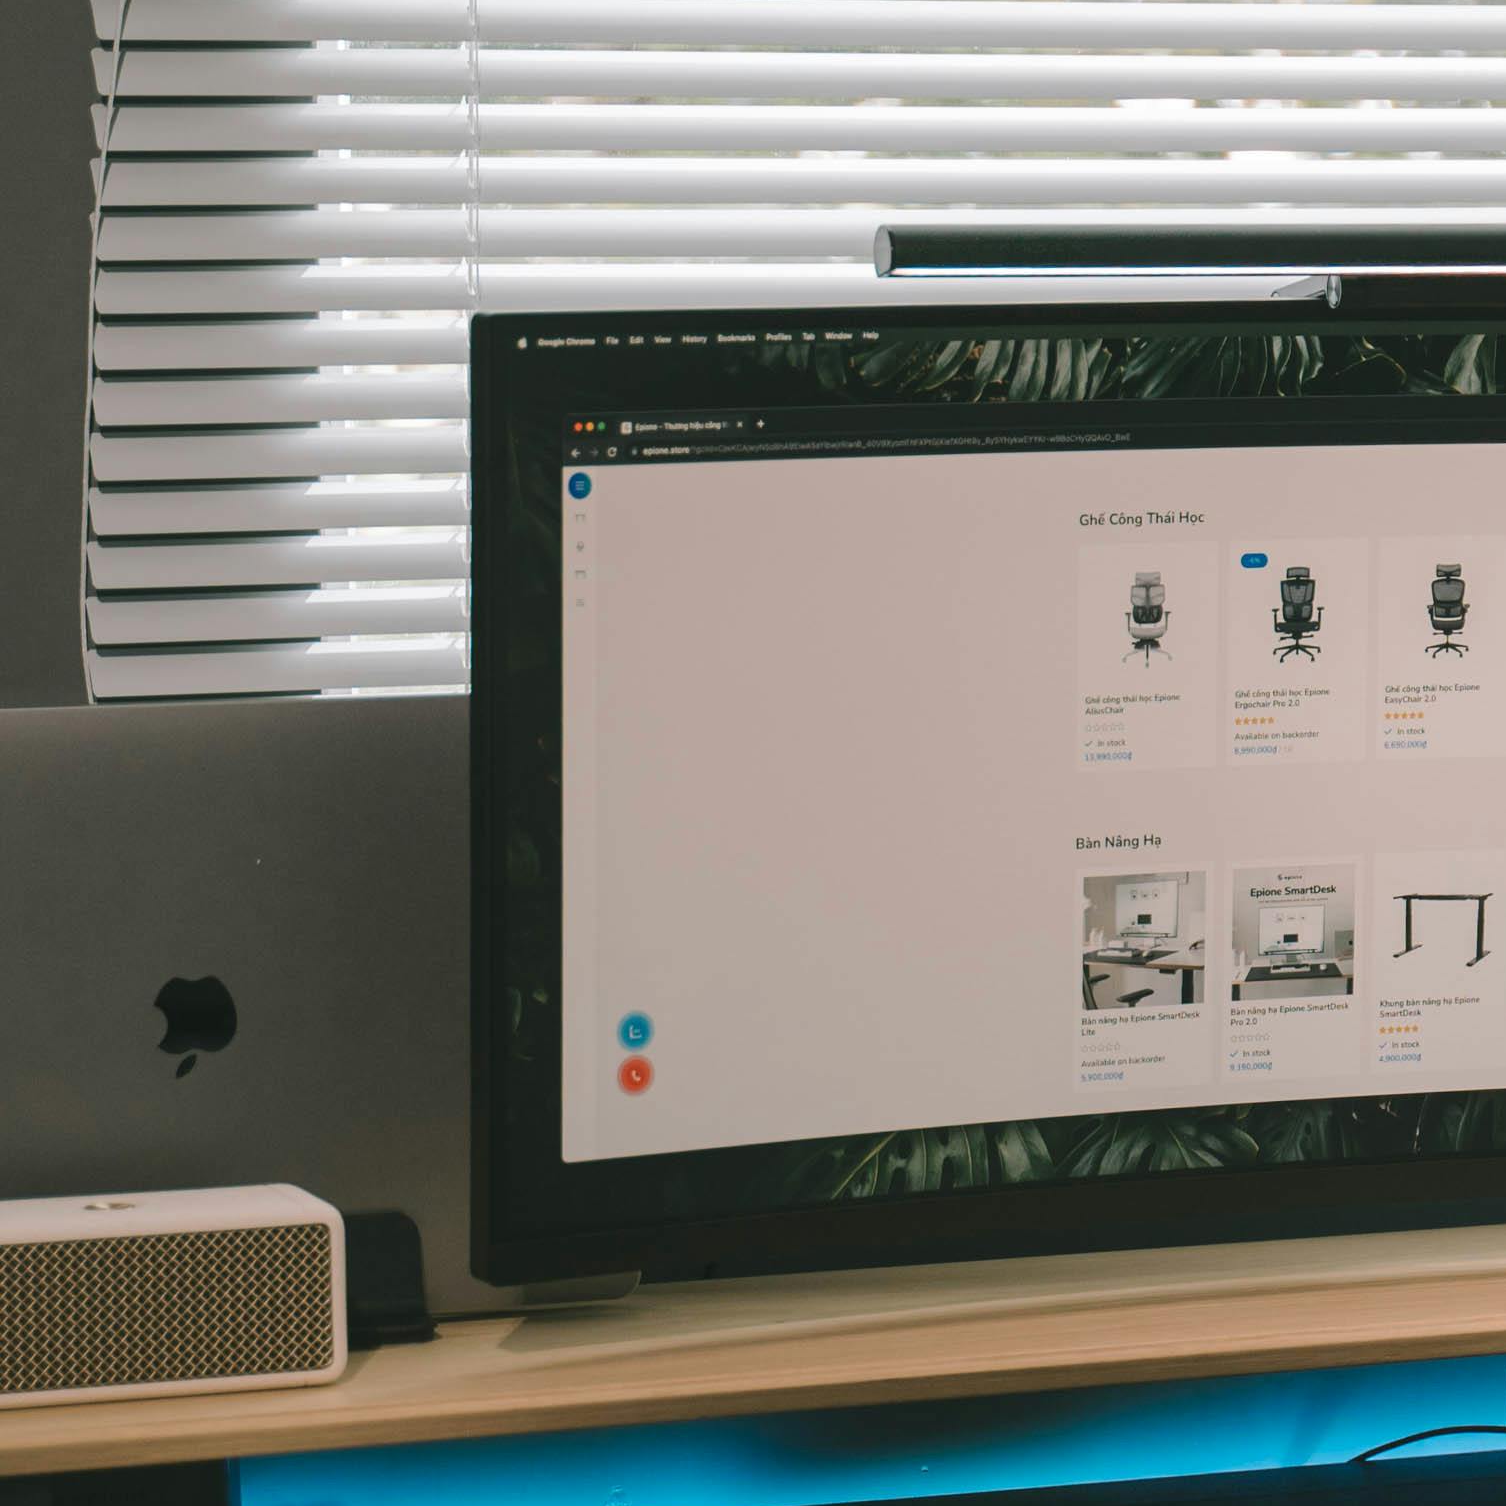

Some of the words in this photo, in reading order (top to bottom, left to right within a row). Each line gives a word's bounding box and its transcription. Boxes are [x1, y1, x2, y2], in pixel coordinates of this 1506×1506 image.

[654, 335, 672, 344] View
[682, 335, 707, 344] History
[718, 333, 756, 342] Bookmarks
[766, 333, 792, 341] Profiles
[825, 332, 852, 340] Window
[863, 331, 879, 341] Help
[1079, 512, 1106, 526] Ghế
[1109, 512, 1143, 527] Công
[1147, 510, 1175, 524] Thái
[1179, 511, 1205, 526] Học
[1272, 699, 1286, 707] Pro
[1384, 695, 1422, 705] EasyChair
[1424, 694, 1437, 703] 2.0
[1076, 836, 1101, 850] Bàn
[1105, 834, 1139, 849] Nâng
[1143, 834, 1162, 849] Hạ
[1250, 887, 1282, 899] Epione
[1284, 884, 1337, 895] SmartDesk
[1279, 1004, 1305, 1014] Epione
[1307, 1001, 1349, 1012] SmartDesk
[1379, 999, 1405, 1008] Khung
[1130, 1013, 1156, 1024] Epione
[1157, 1010, 1201, 1021] SmartDesk
[1379, 1009, 1422, 1018] SmartDesk
[1230, 1018, 1244, 1027] Pro
[1245, 1017, 1258, 1026] 2.0
[1081, 1028, 1096, 1037] Lite
[1400, 1041, 1420, 1049] stock
[1251, 1049, 1271, 1057] stock
